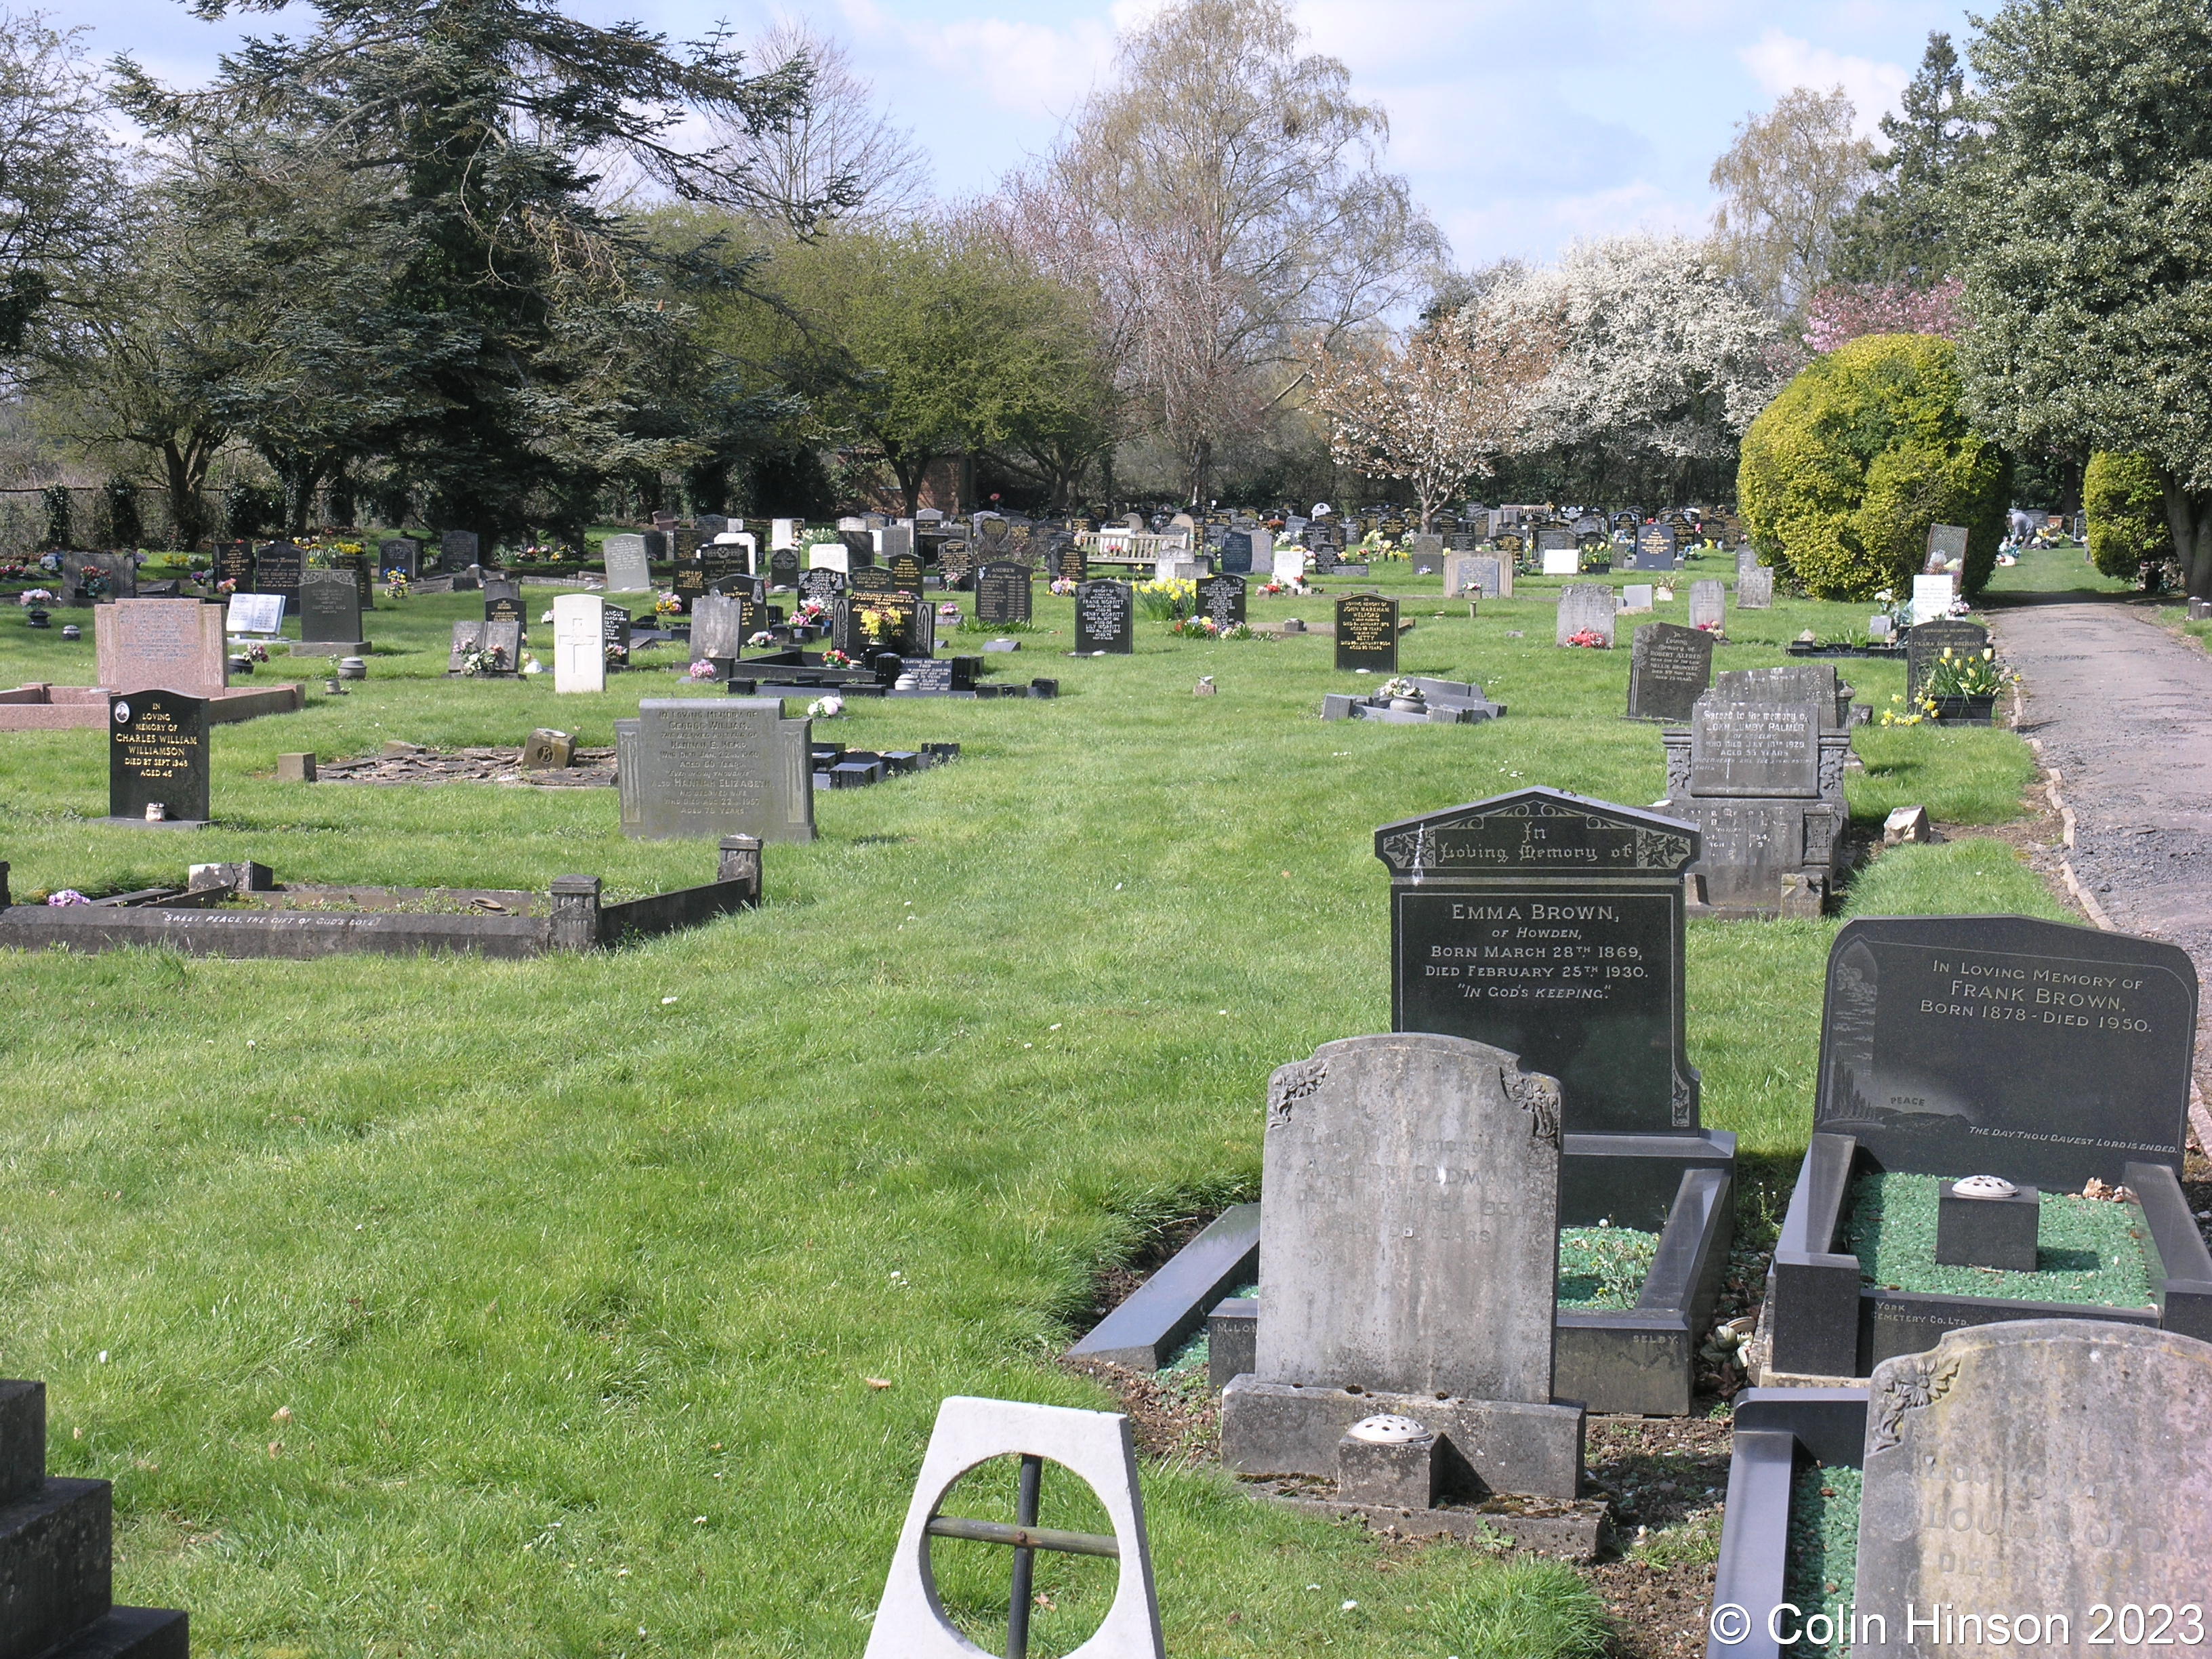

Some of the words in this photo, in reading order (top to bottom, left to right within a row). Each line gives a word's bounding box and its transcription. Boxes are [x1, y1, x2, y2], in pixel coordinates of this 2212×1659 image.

[1666, 638, 1688, 646] Loving
[142, 713, 171, 721] LOVING
[659, 711, 669, 720] IN
[672, 711, 703, 719] LOVING
[707, 711, 743, 720] MEMORY
[1702, 710, 1733, 720] Sacred
[1737, 712, 1744, 720] to
[1748, 712, 1761, 720] the
[1763, 712, 1796, 723] memory
[136, 723, 166, 731] MEMORY
[167, 724, 178, 732] OF
[668, 721, 706, 730] GEORGE
[1768, 722, 1805, 732] PALMER
[116, 733, 157, 743] CHARLES
[159, 735, 198, 745] WILLIAM
[671, 741, 707, 749] HANNAH
[710, 741, 718, 749] E.
[128, 746, 185, 756] WILLIAMSON
[143, 758, 152, 766] 27
[154, 758, 171, 766] SEPT
[674, 779, 717, 787] HANNAH
[1522, 821, 1547, 843] In
[1439, 842, 1509, 863] Loving
[1519, 844, 1597, 862] Memory
[1611, 843, 1633, 857] of
[1452, 903, 1522, 920] EMMA
[1530, 903, 1619, 922] BROWN,
[205, 916, 243, 924] PEACE,
[271, 916, 295, 924] GIFT
[316, 917, 345, 926] GOD'S
[1491, 929, 1509, 938] OF
[1516, 927, 1582, 940] HOWDEN,
[1431, 945, 1477, 957] BORN
[1484, 945, 1546, 958] MARCH
[1598, 946, 1642, 960] 1869,
[1425, 965, 1459, 977] DIED
[1468, 965, 1554, 977] FEBRUARY
[1605, 966, 1648, 978] 1930.
[1933, 960, 1950, 973] IN
[1961, 962, 2025, 980] LOVING
[2033, 970, 2116, 987] MEMORY
[2122, 979, 2144, 989] OF
[1488, 984, 1528, 998] GOD'S
[1950, 980, 2026, 1002] FRANK
[2035, 987, 2126, 1012] BROWN,
[1921, 1000, 1973, 1017] BORN
[1982, 1006, 2026, 1021] 1878
[2043, 1011, 2089, 1026] DIED
[2098, 1017, 2152, 1033] 1950.
[1890, 1096, 1926, 1107] PEACE
[1969, 1126, 1990, 1136] THE
[1992, 1129, 2015, 1137] DAY
[2017, 1131, 2049, 1141] THOU
[2096, 1138, 2127, 1149] LORD
[2127, 1141, 2137, 1150] IS
[2139, 1143, 2177, 1153] ENDED.
[1876, 1302, 1905, 1311] YORK
[1873, 1312, 1926, 1323] CEMETERY
[1930, 1315, 1945, 1324] CO.
[1948, 1317, 1970, 1326] LTD.
